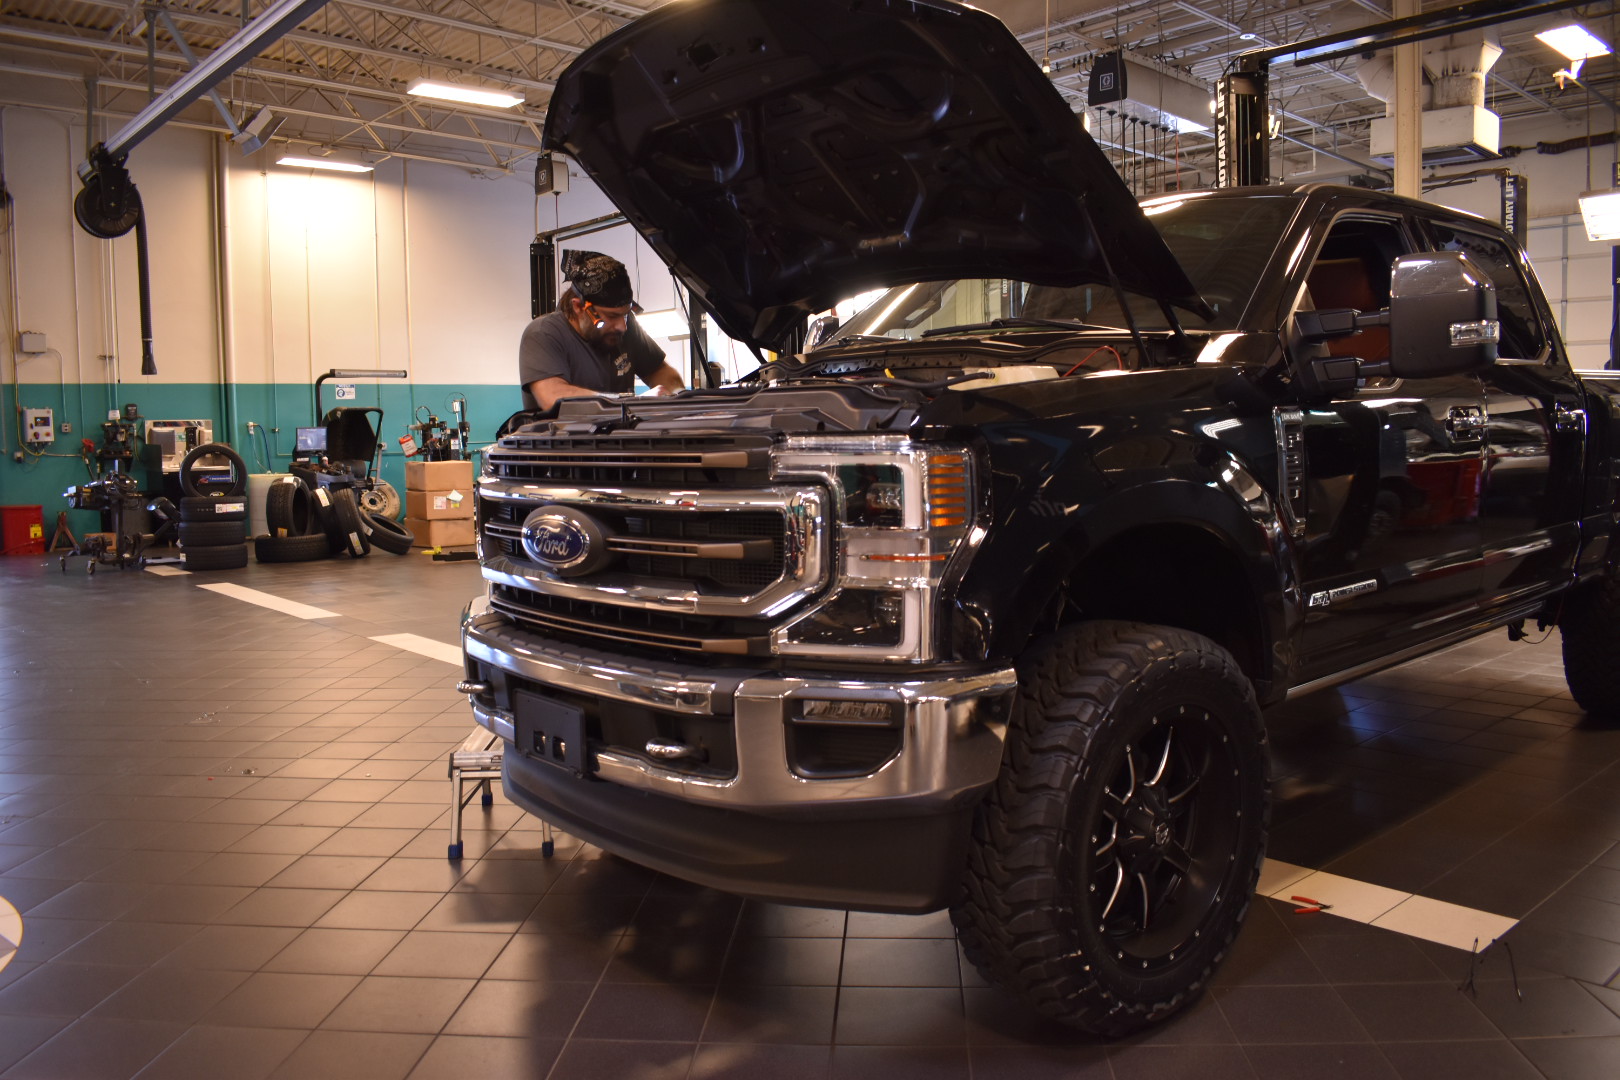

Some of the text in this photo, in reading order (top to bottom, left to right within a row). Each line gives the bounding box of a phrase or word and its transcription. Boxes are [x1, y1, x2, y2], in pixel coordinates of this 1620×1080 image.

[1217, 79, 1225, 119] LIFT
[1505, 177, 1514, 234] OTARY LIFT
[533, 524, 570, 556] Ford
